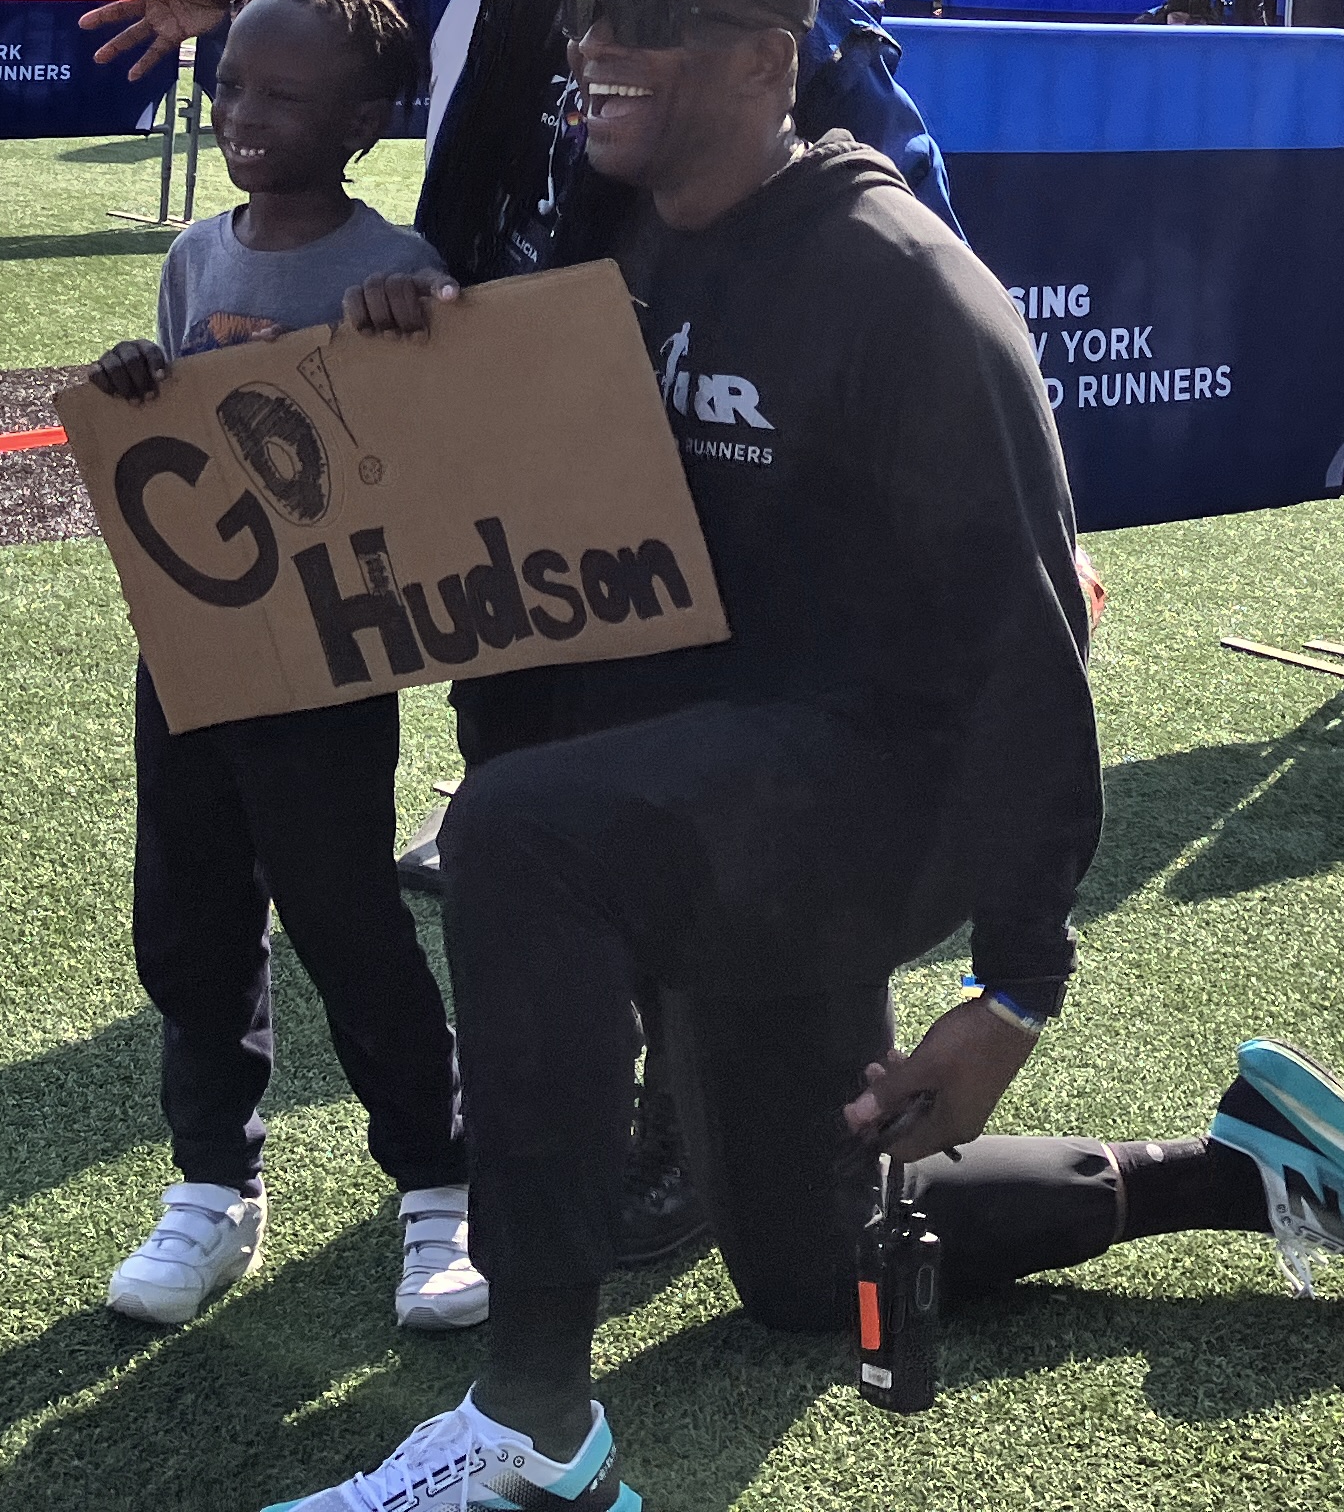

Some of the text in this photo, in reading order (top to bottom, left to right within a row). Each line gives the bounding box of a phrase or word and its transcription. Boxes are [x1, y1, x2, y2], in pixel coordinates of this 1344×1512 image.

[1008, 284, 1091, 319] SING
[1062, 326, 1154, 363] YORK
[1079, 365, 1232, 408] RUNNERS
[686, 438, 773, 465] RUNNERS
[291, 517, 694, 688] Hudson
